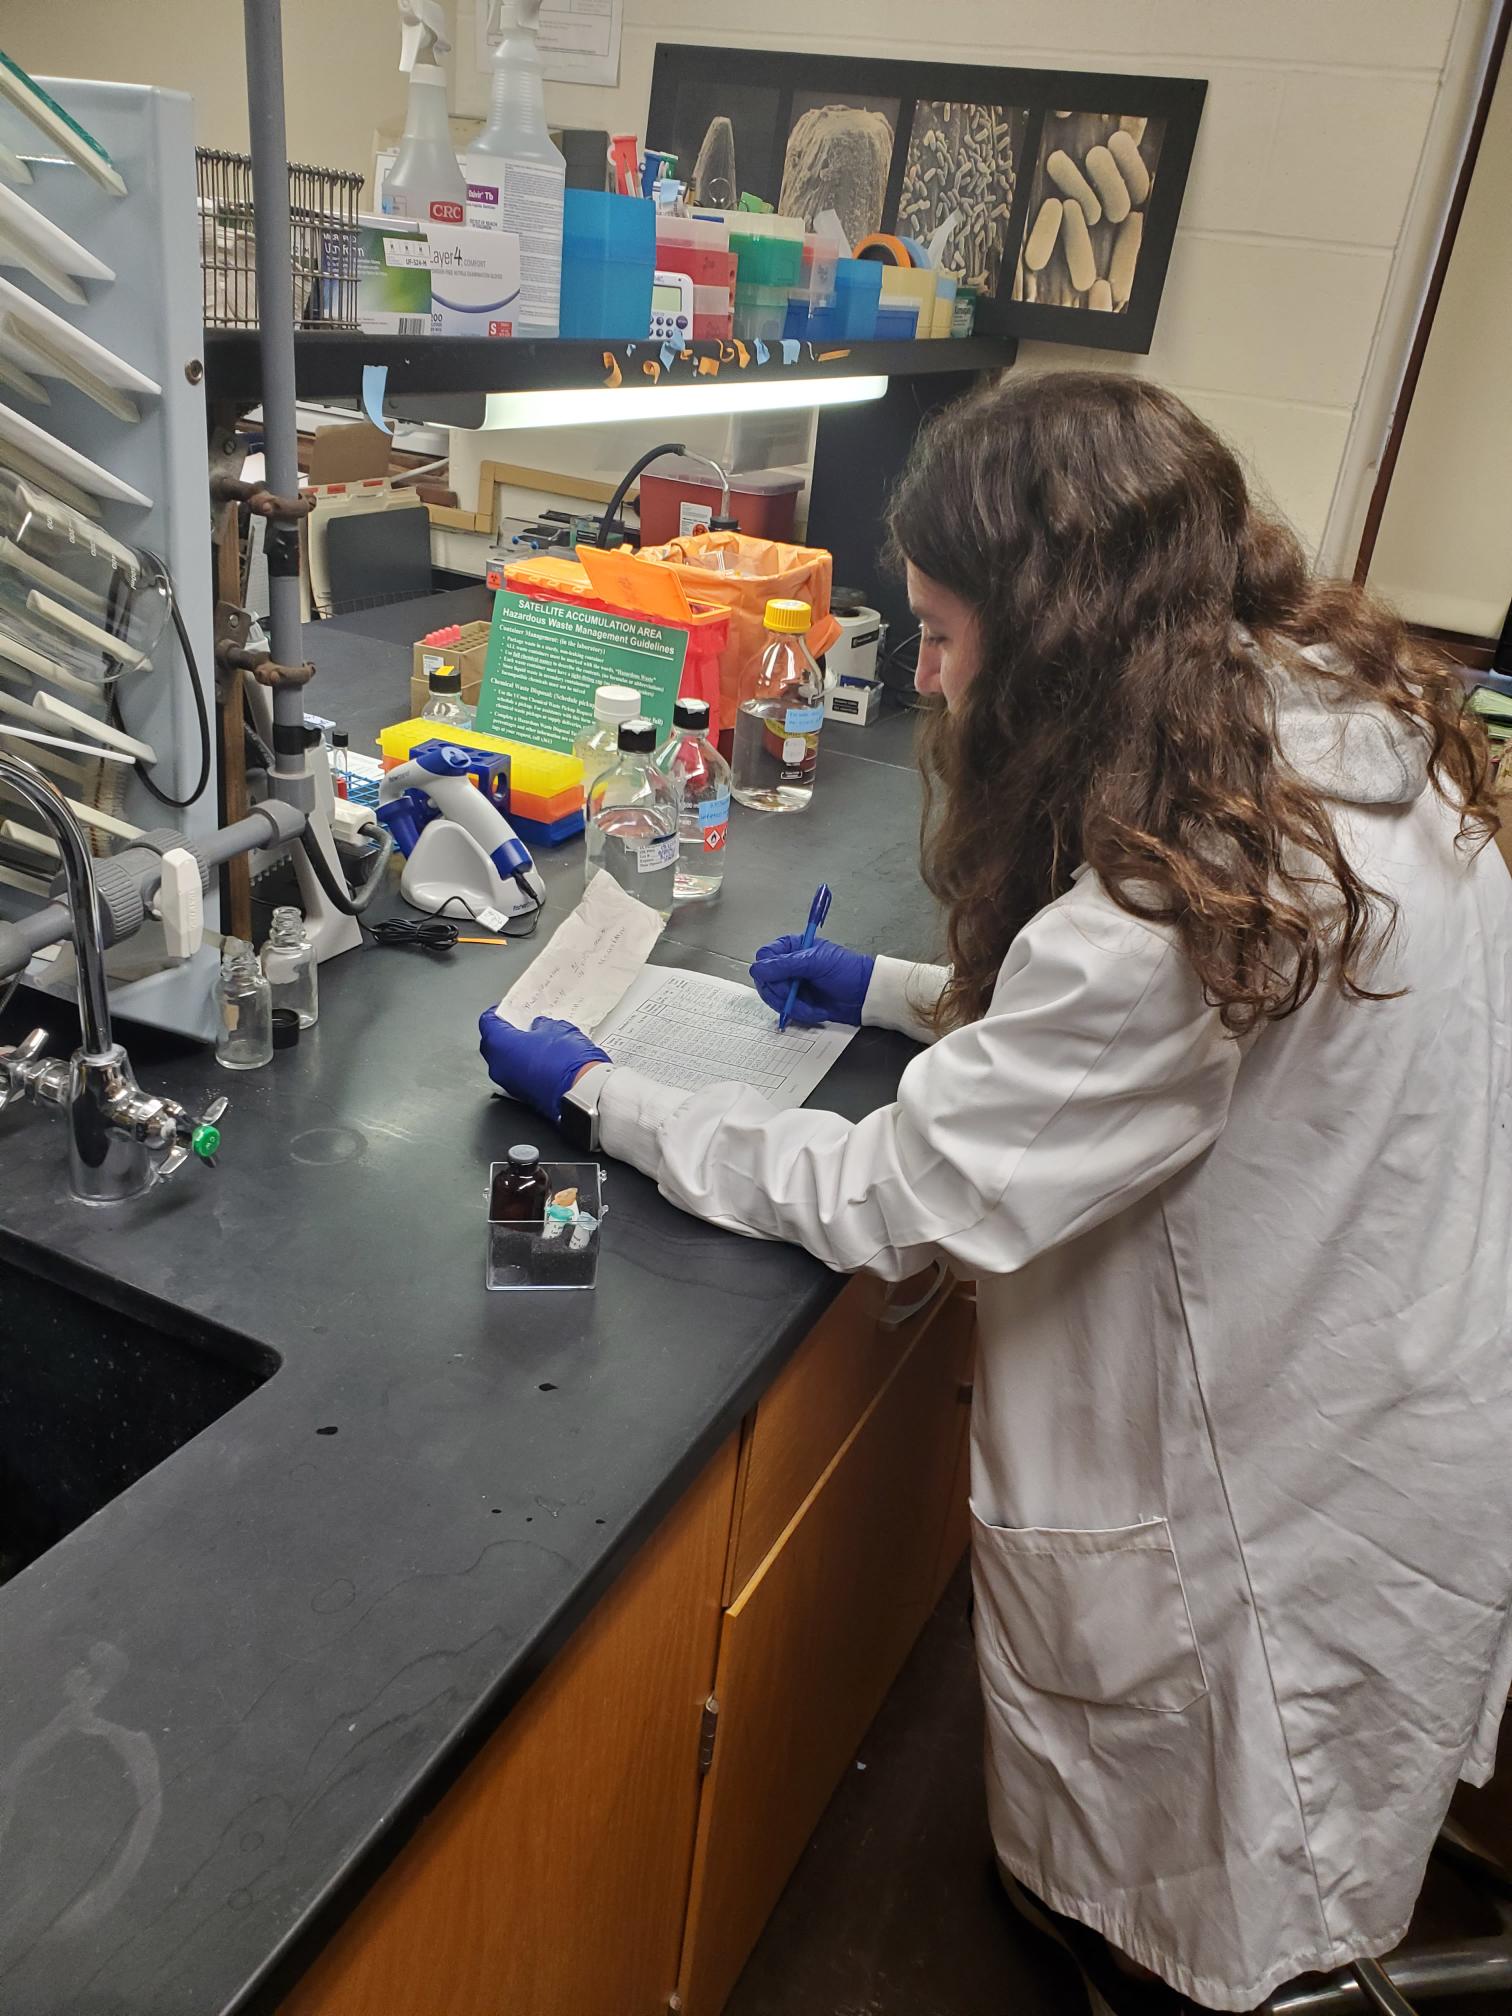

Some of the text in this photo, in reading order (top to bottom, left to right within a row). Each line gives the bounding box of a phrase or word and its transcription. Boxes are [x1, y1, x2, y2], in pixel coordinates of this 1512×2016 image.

[432, 204, 461, 219] CRC
[490, 322, 496, 335] S
[502, 607, 674, 654] Hazardous Waste Management Guidelines
[518, 599, 662, 640] SATELLITE ACCUMULATION AREA
[499, 624, 524, 634] Container
[576, 642, 605, 654] laboratory)
[490, 677, 514, 688] Chemical
[514, 682, 529, 691] Waste
